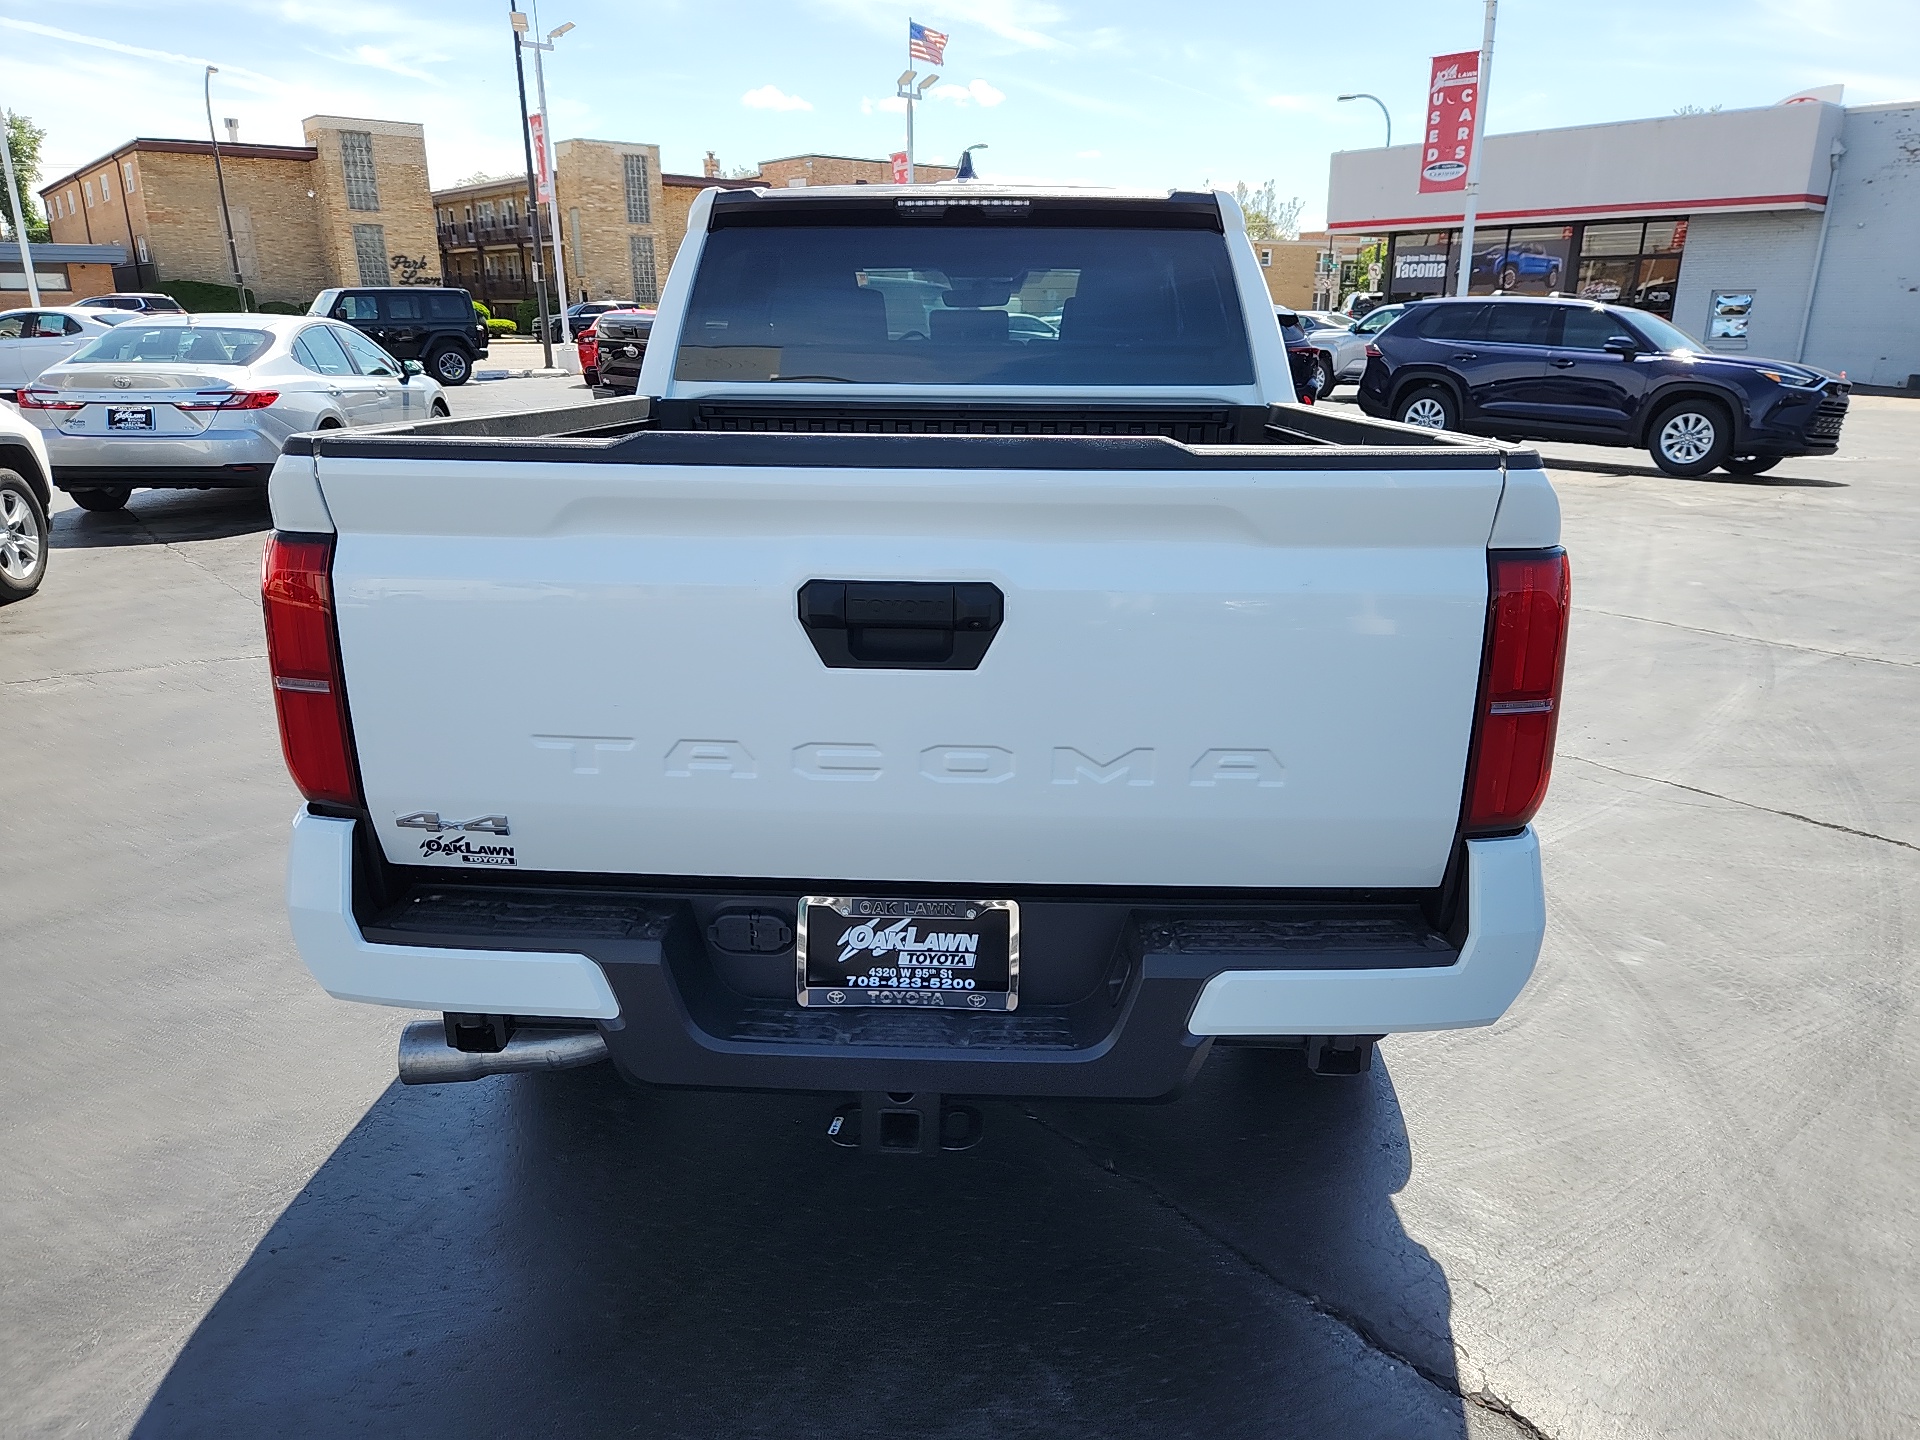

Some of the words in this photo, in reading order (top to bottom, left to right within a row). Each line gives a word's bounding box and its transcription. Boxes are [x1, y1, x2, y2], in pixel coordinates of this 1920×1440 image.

[1426, 91, 1444, 162] USED
[1454, 88, 1473, 159] CARS
[390, 255, 427, 269] Park
[399, 270, 441, 286] Lawn
[1395, 262, 1447, 279] Tacoma
[531, 734, 1287, 788] TACOMA
[467, 855, 511, 865] TOYOTA
[859, 900, 898, 915] OAK
[904, 901, 956, 916] LAWN
[906, 952, 968, 966] TOYOTA
[868, 967, 897, 978] 4320
[900, 968, 911, 978] W
[915, 968, 937, 979] 95th
[939, 969, 953, 979] St
[846, 975, 976, 989] 708-423-5200
[866, 990, 946, 1006] TOYOTA
